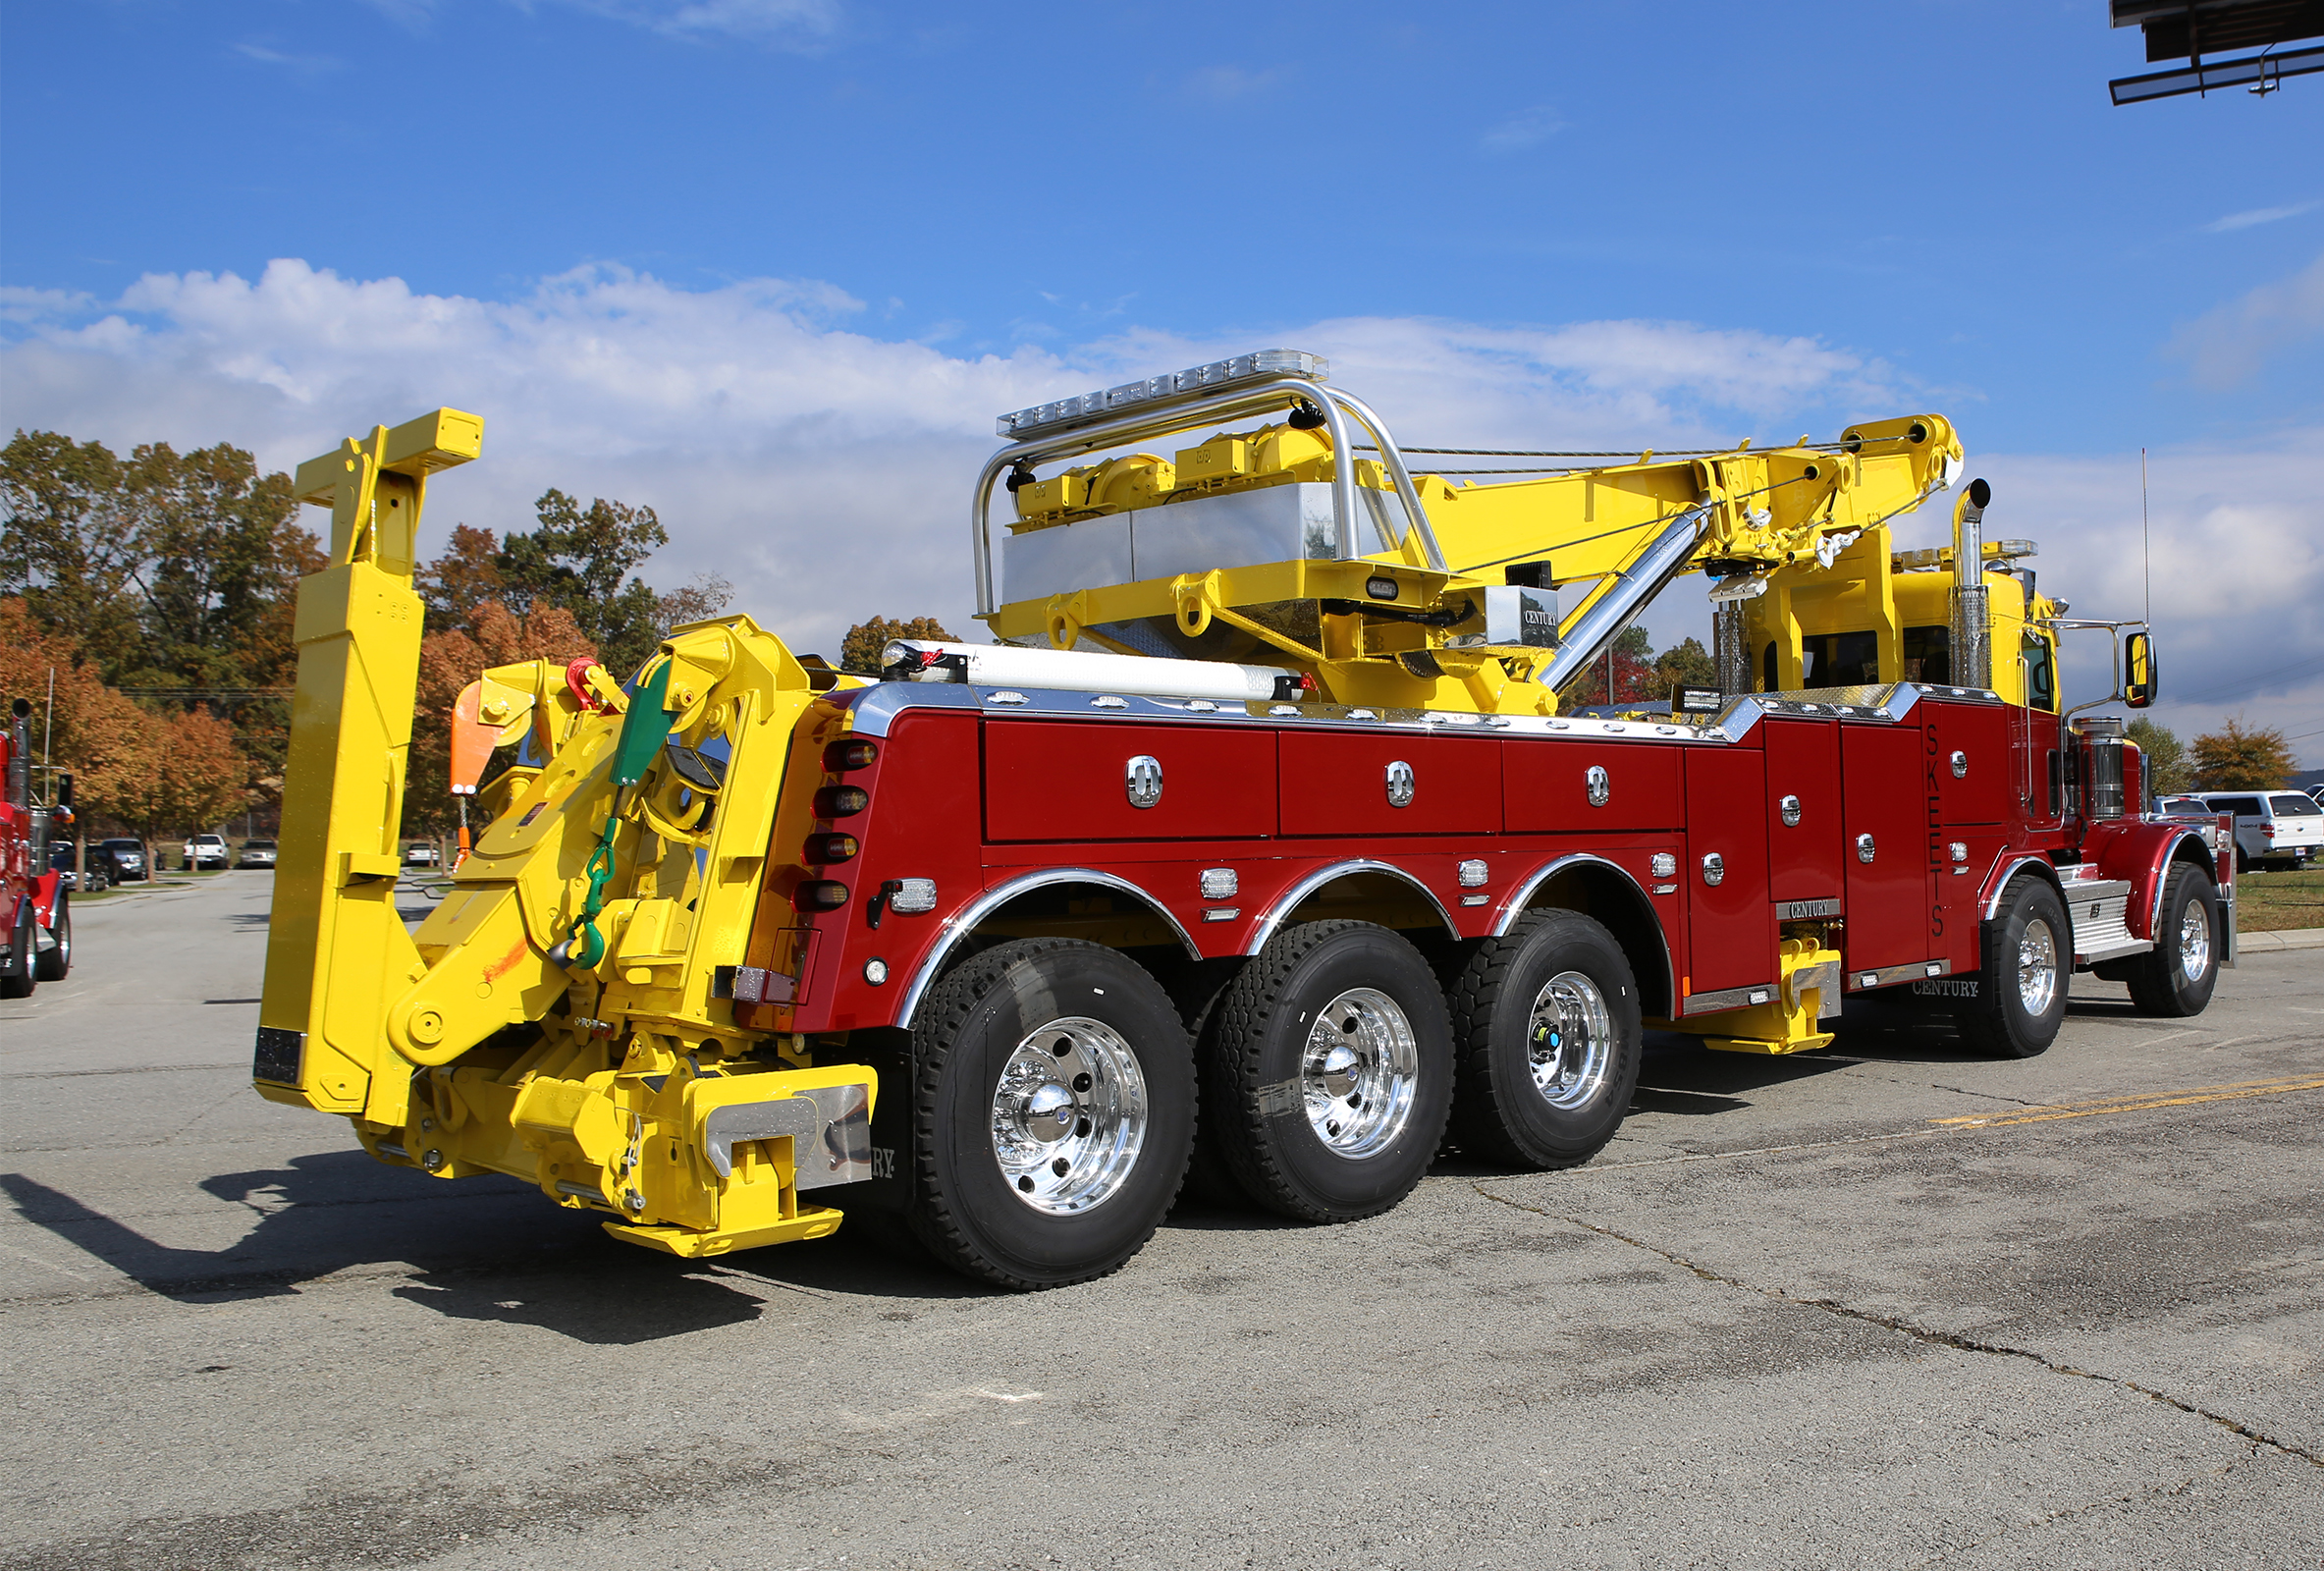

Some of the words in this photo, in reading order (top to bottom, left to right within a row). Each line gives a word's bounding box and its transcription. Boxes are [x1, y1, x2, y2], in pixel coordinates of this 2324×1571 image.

[1525, 610, 1556, 626] CENTURY
[1926, 724, 1944, 937] SKEETS
[1790, 899, 1828, 919] CENTURY
[1912, 980, 1978, 998] CENTURY
